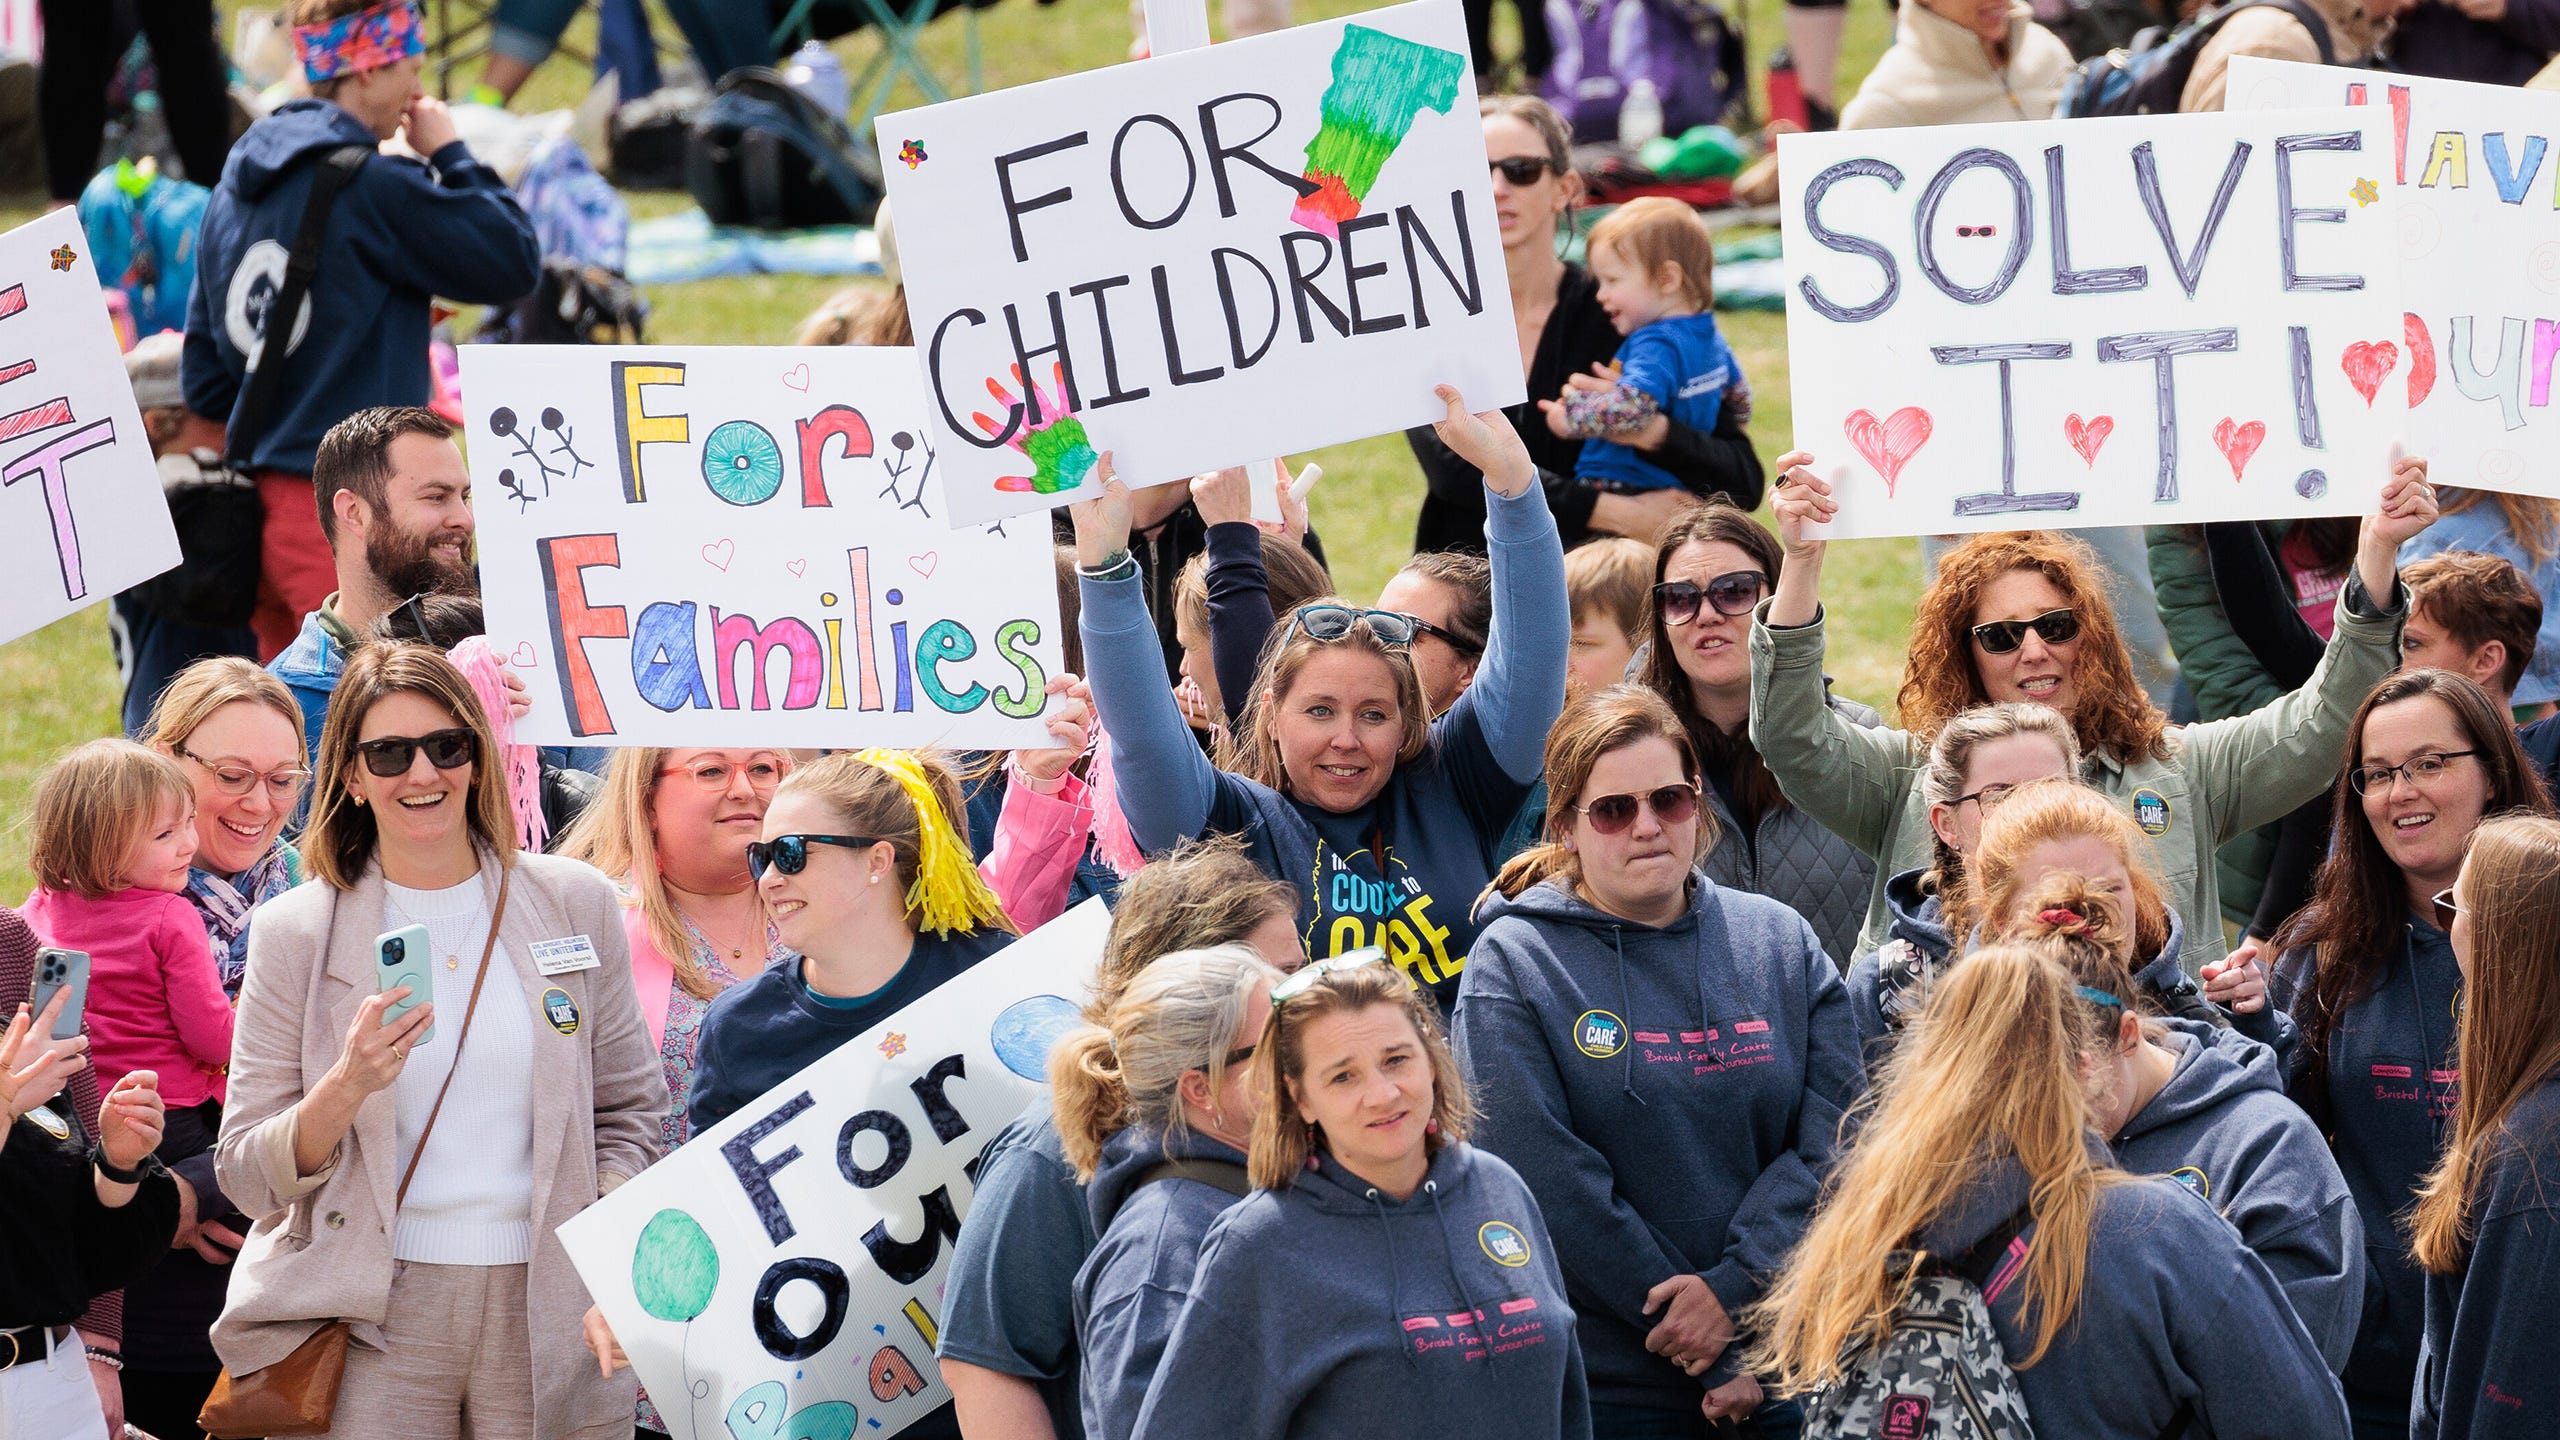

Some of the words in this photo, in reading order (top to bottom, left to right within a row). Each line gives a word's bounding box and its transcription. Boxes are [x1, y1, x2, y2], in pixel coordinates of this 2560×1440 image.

[994, 92, 1323, 263] FOR
[2345, 83, 2560, 212] AV
[1799, 130, 2367, 323] SOLVE
[928, 189, 1484, 449] CHILDREN
[610, 360, 875, 508] For
[1930, 326, 2329, 517] IT!
[536, 532, 1048, 738] Families
[2141, 805, 2164, 825] CARE
[551, 1004, 576, 1023] CARE
[1586, 1026, 1617, 1047] CARE
[1644, 1049, 1683, 1063] Bristol
[1687, 1047, 1726, 1062] Famly
[1730, 1042, 1771, 1055] Center
[720, 1053, 972, 1248] For
[2375, 1085, 2419, 1100] Bristol
[752, 1156, 982, 1362] ou
[1492, 1236, 1523, 1257] CARE
[1415, 1334, 1455, 1353] Bristol
[1498, 1322, 1541, 1338] Center
